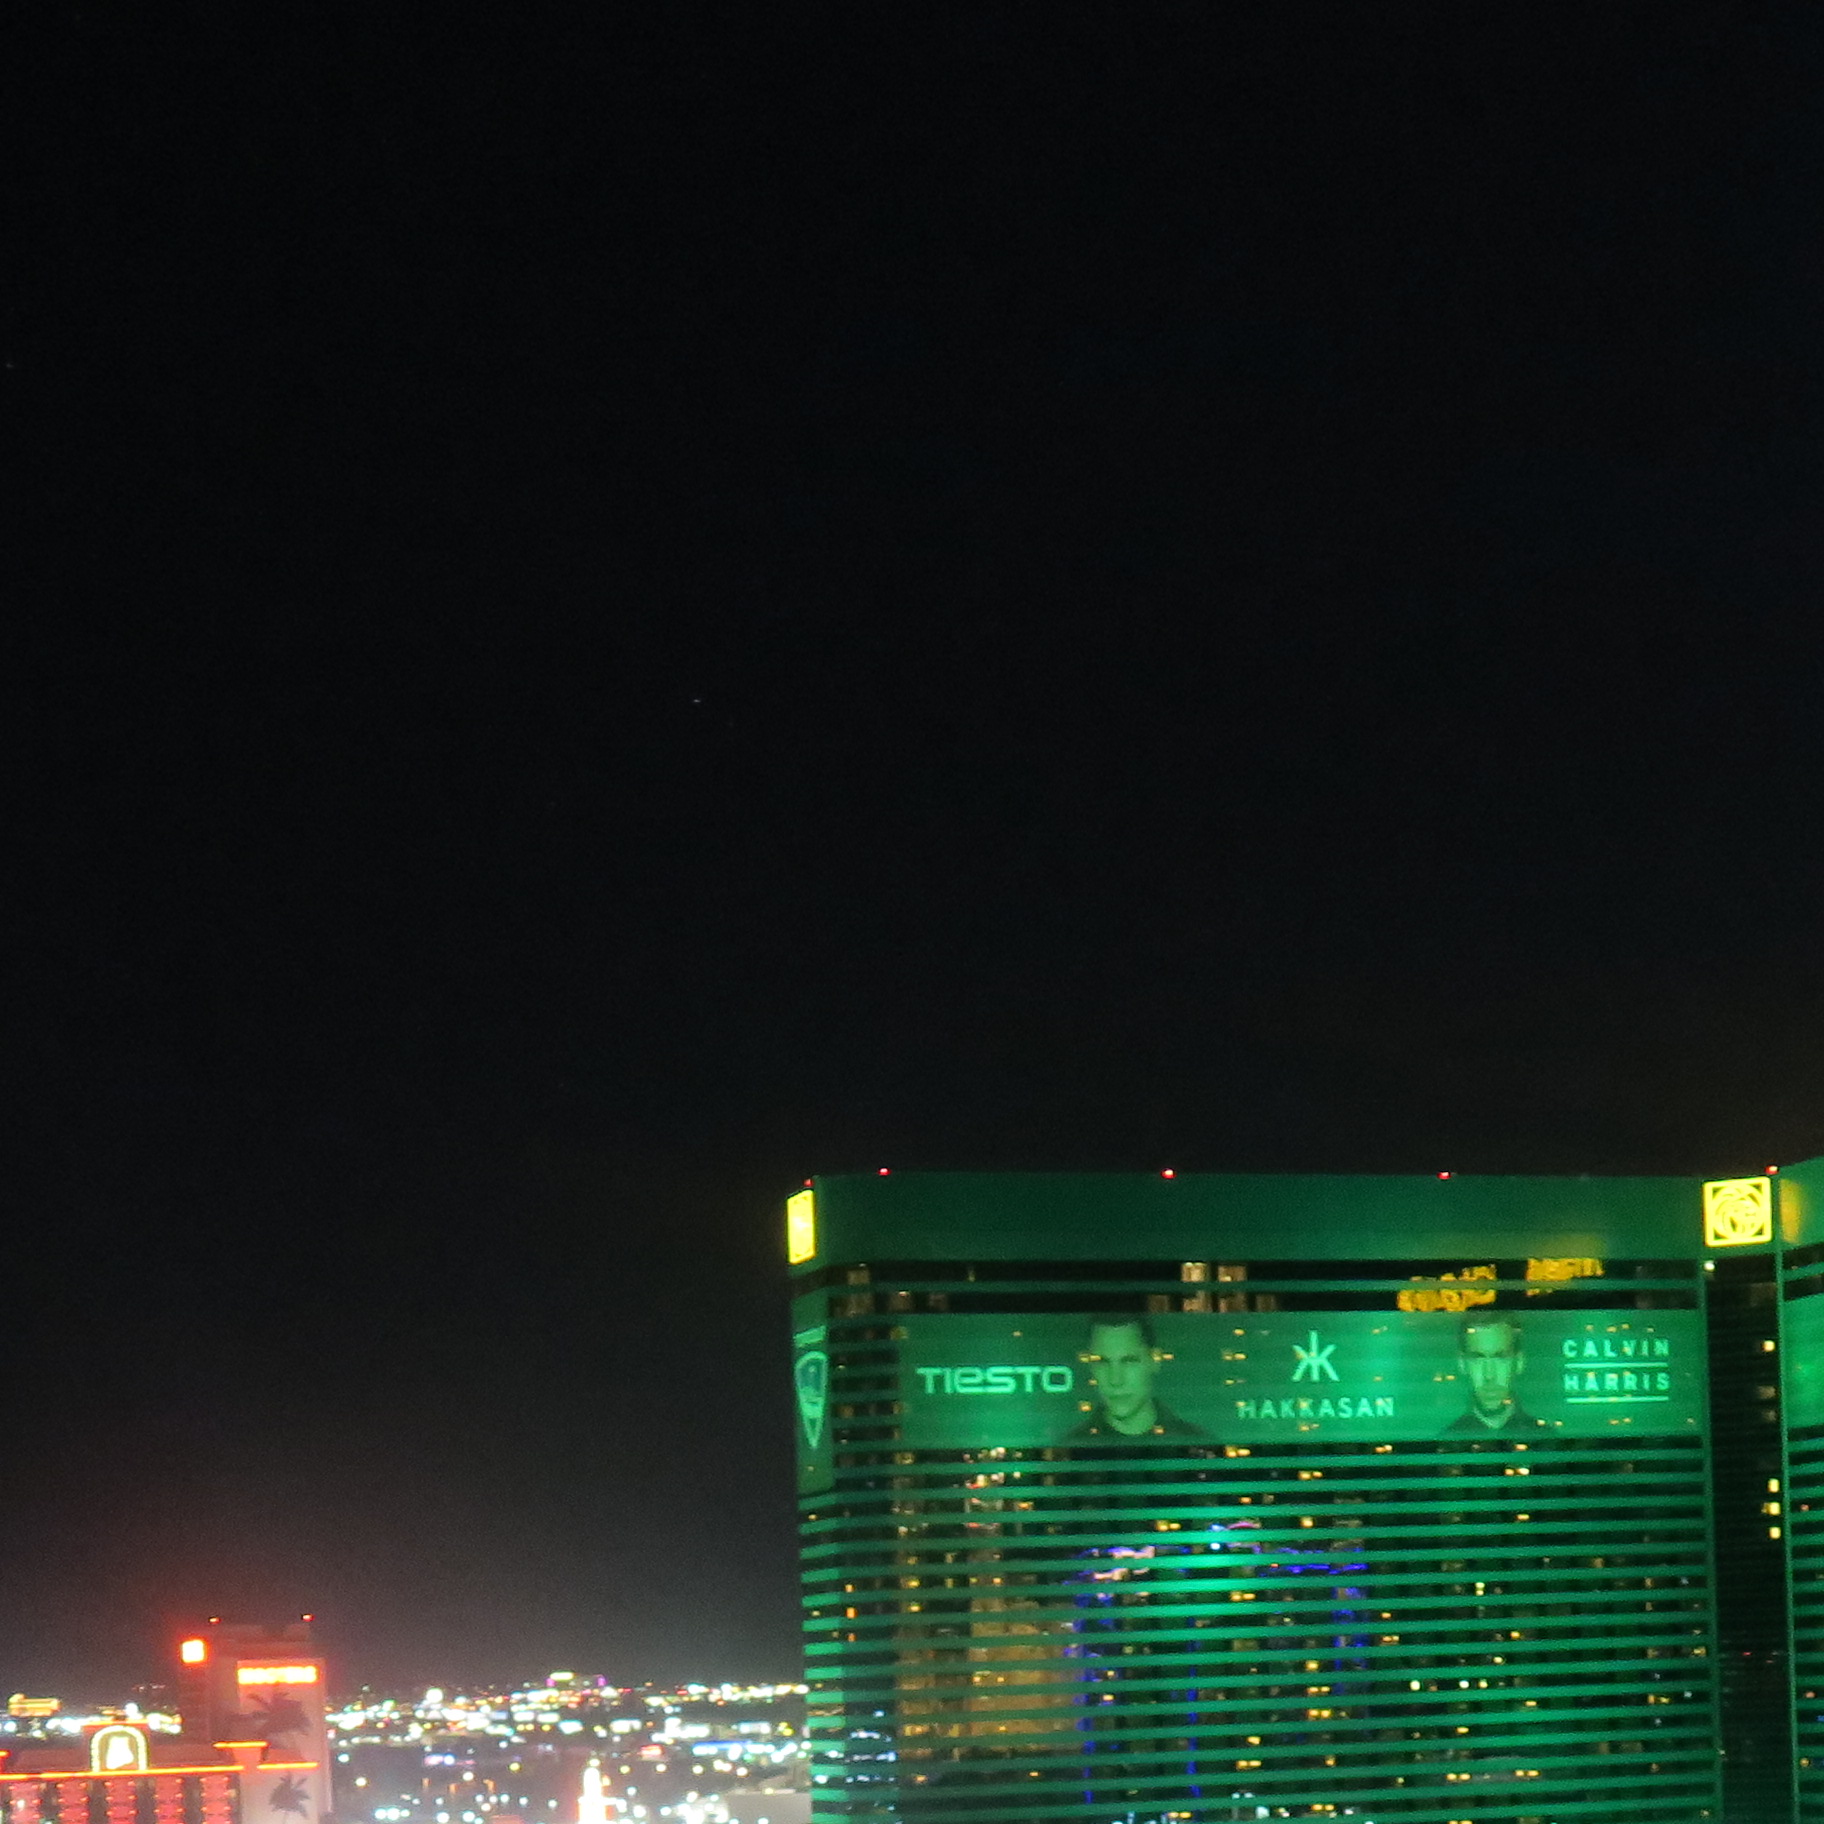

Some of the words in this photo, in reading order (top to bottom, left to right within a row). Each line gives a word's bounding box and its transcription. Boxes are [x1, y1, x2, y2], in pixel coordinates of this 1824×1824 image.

[1562, 1339, 1669, 1358] CALVIN
[1563, 1372, 1670, 1392] HARRIS
[1237, 1397, 1395, 1419] HAKKASAN
